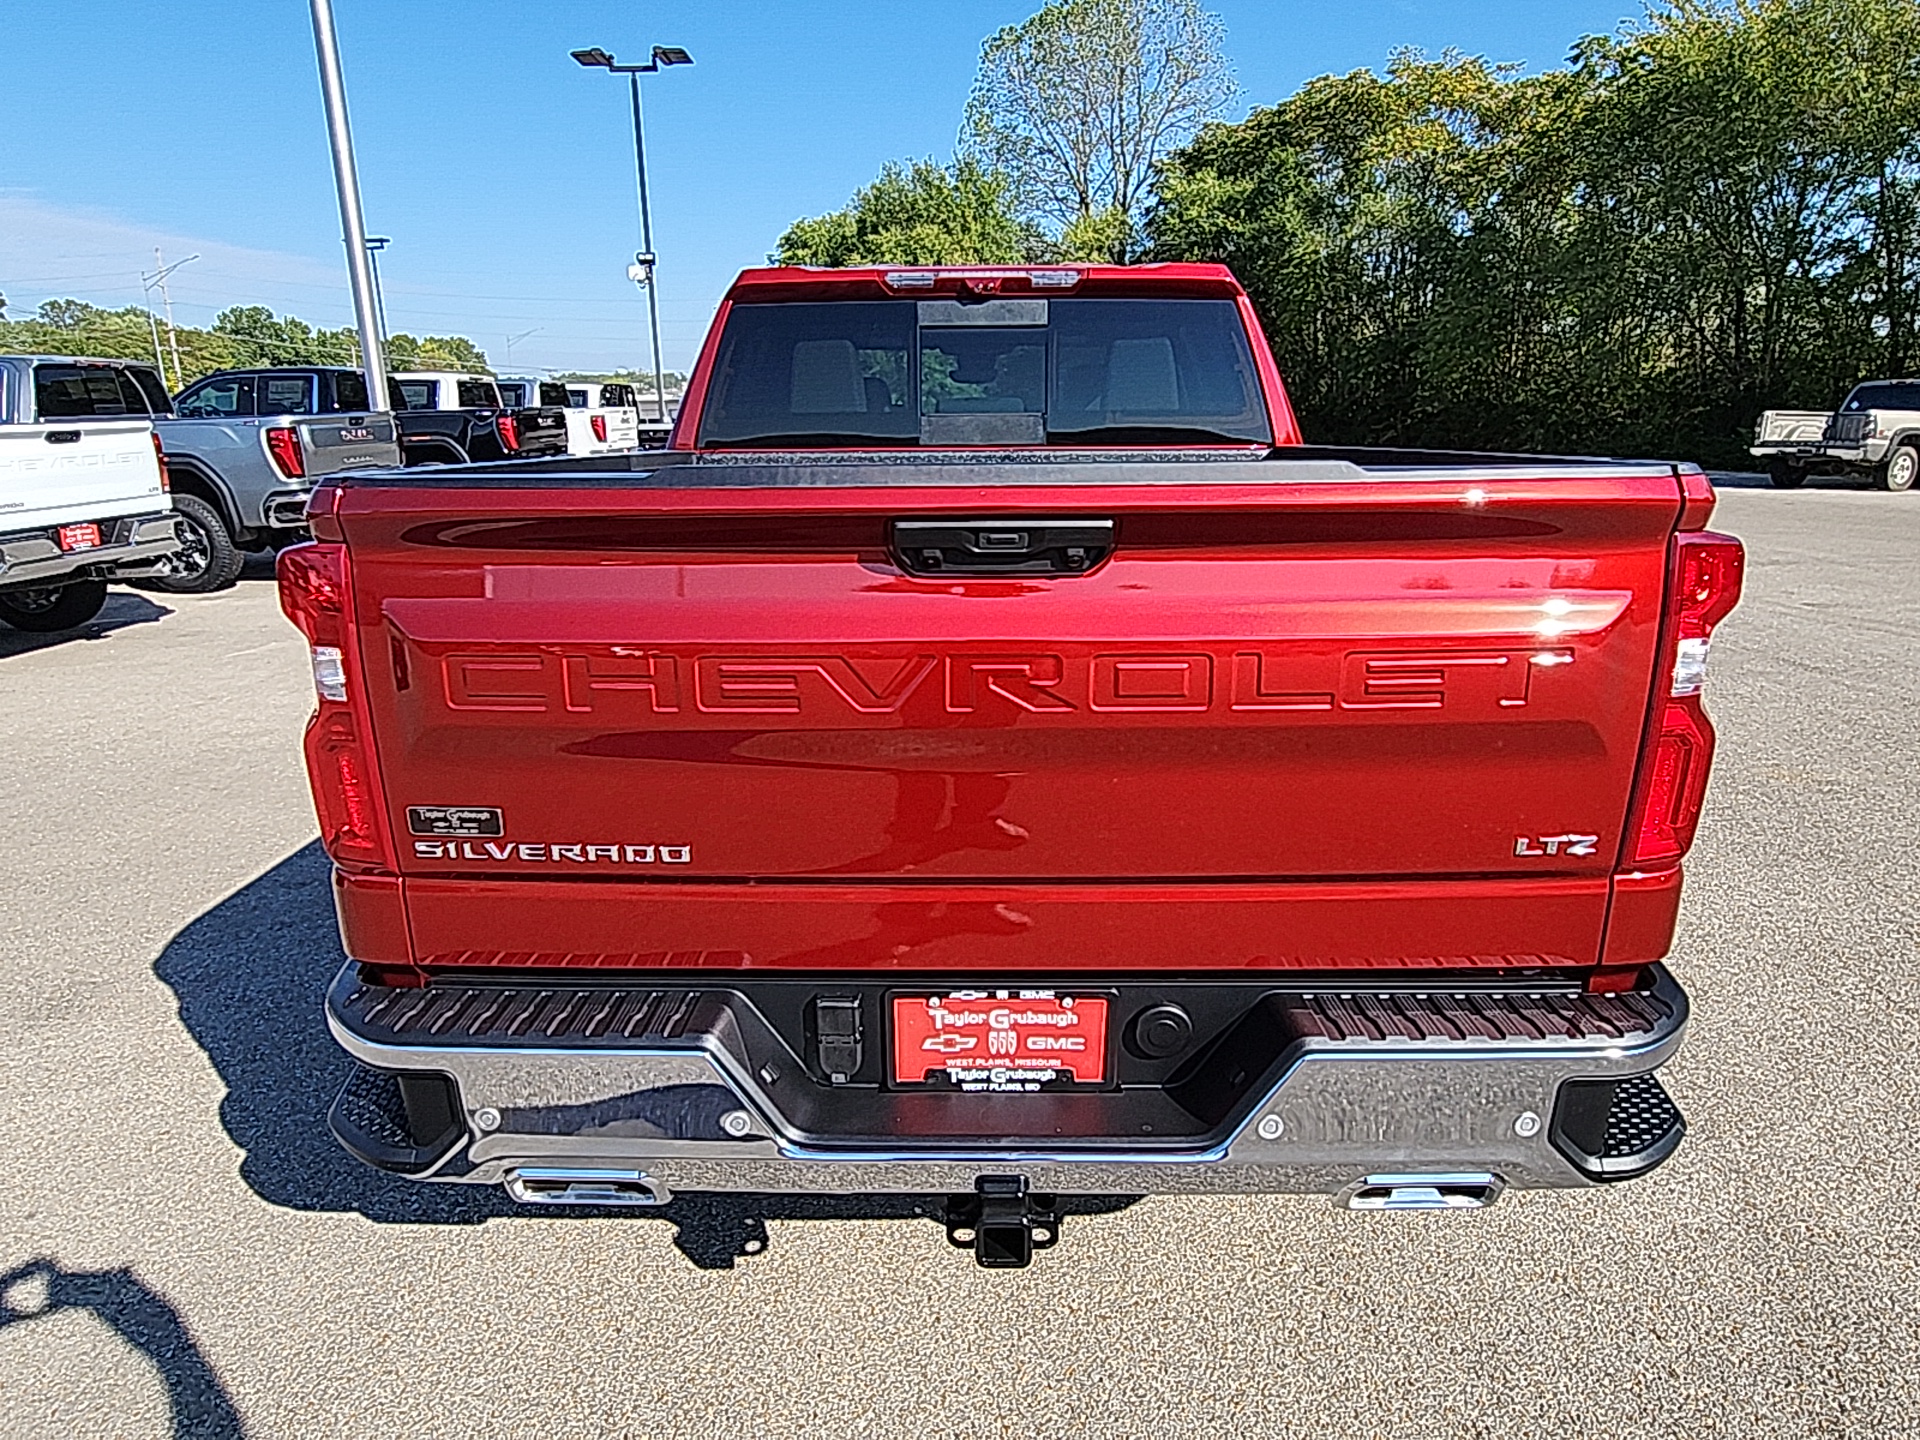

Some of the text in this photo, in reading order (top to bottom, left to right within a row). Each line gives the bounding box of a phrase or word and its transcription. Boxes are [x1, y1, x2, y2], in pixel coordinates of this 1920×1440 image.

[441, 648, 1575, 713] CHEVROLET
[414, 841, 691, 863] SILVERADO
[1515, 834, 1599, 856] LTZ
[929, 1008, 1079, 1030] Taylor Grubaugh
[1027, 1036, 1087, 1051] GMC
[945, 1058, 974, 1067] WEST
[1014, 1058, 1062, 1067] MISSOURI
[946, 1067, 1057, 1083] Taylor Grubaugh
